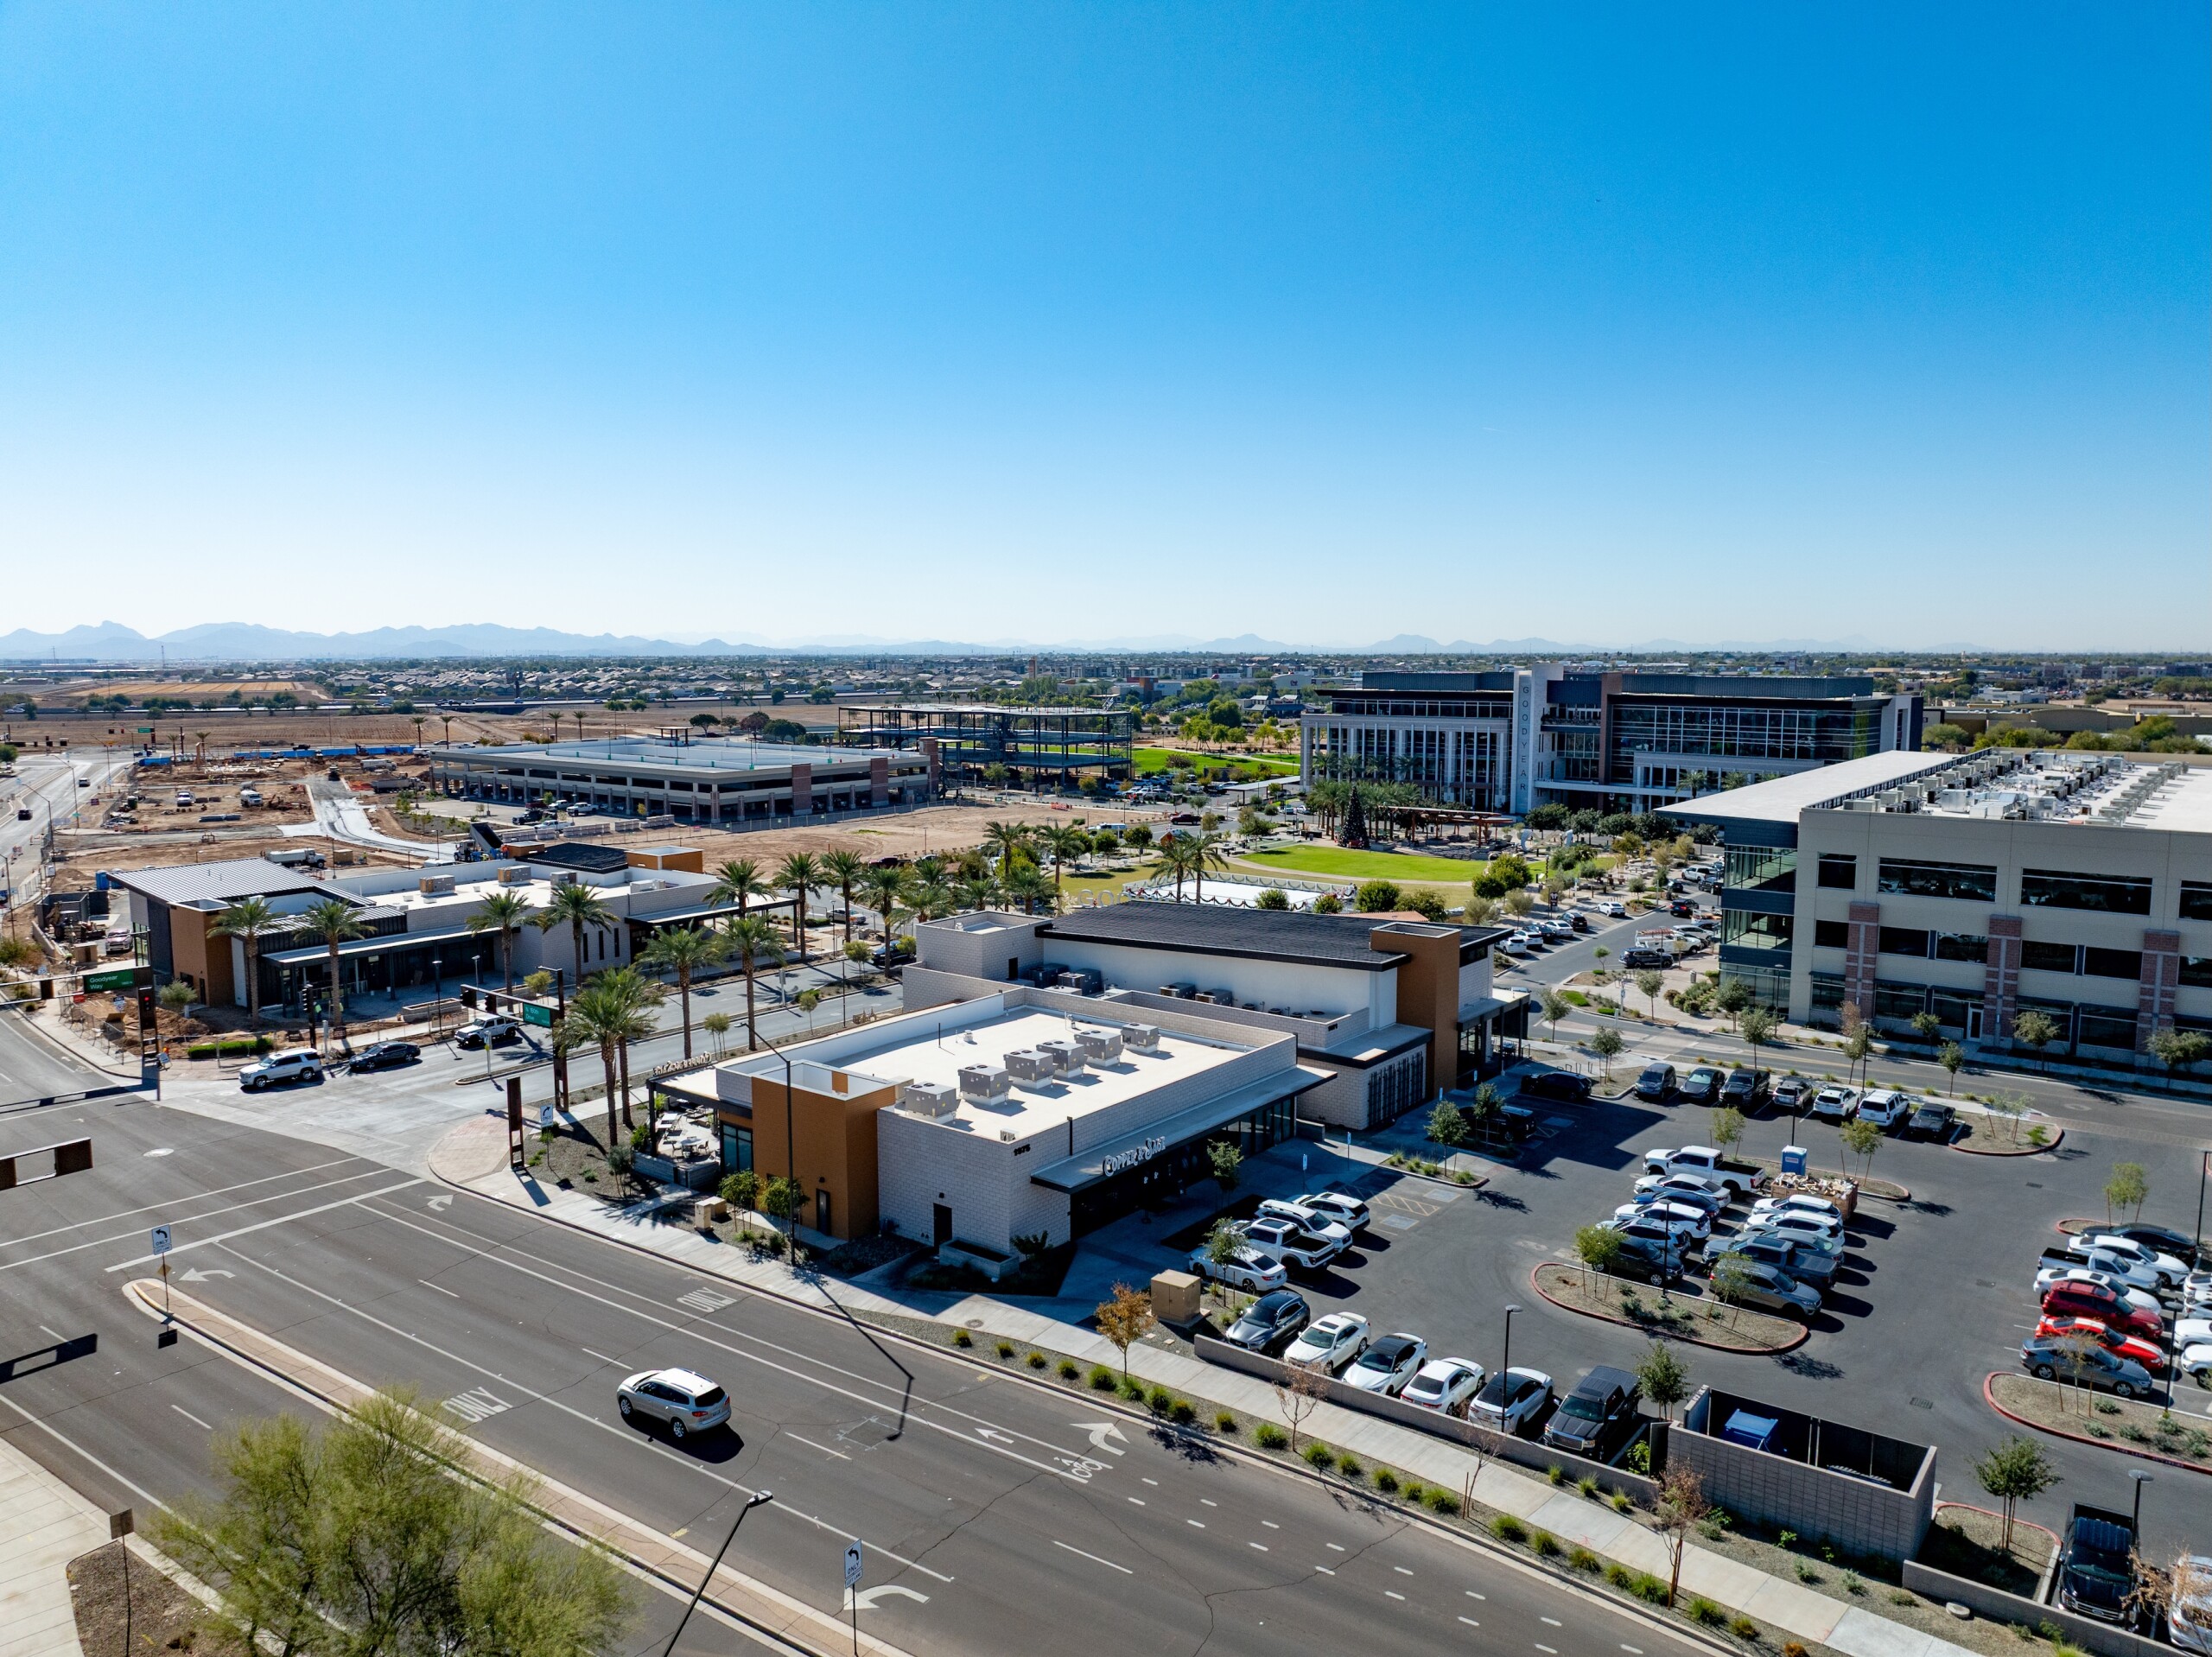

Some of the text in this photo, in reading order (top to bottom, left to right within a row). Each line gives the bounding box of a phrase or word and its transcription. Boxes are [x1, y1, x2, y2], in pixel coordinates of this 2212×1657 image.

[1520, 686, 1529, 790] GOODYEAR
[677, 1286, 738, 1313] ONLY
[441, 1386, 514, 1423] ONLY
[848, 1561, 860, 1574] ONLY
